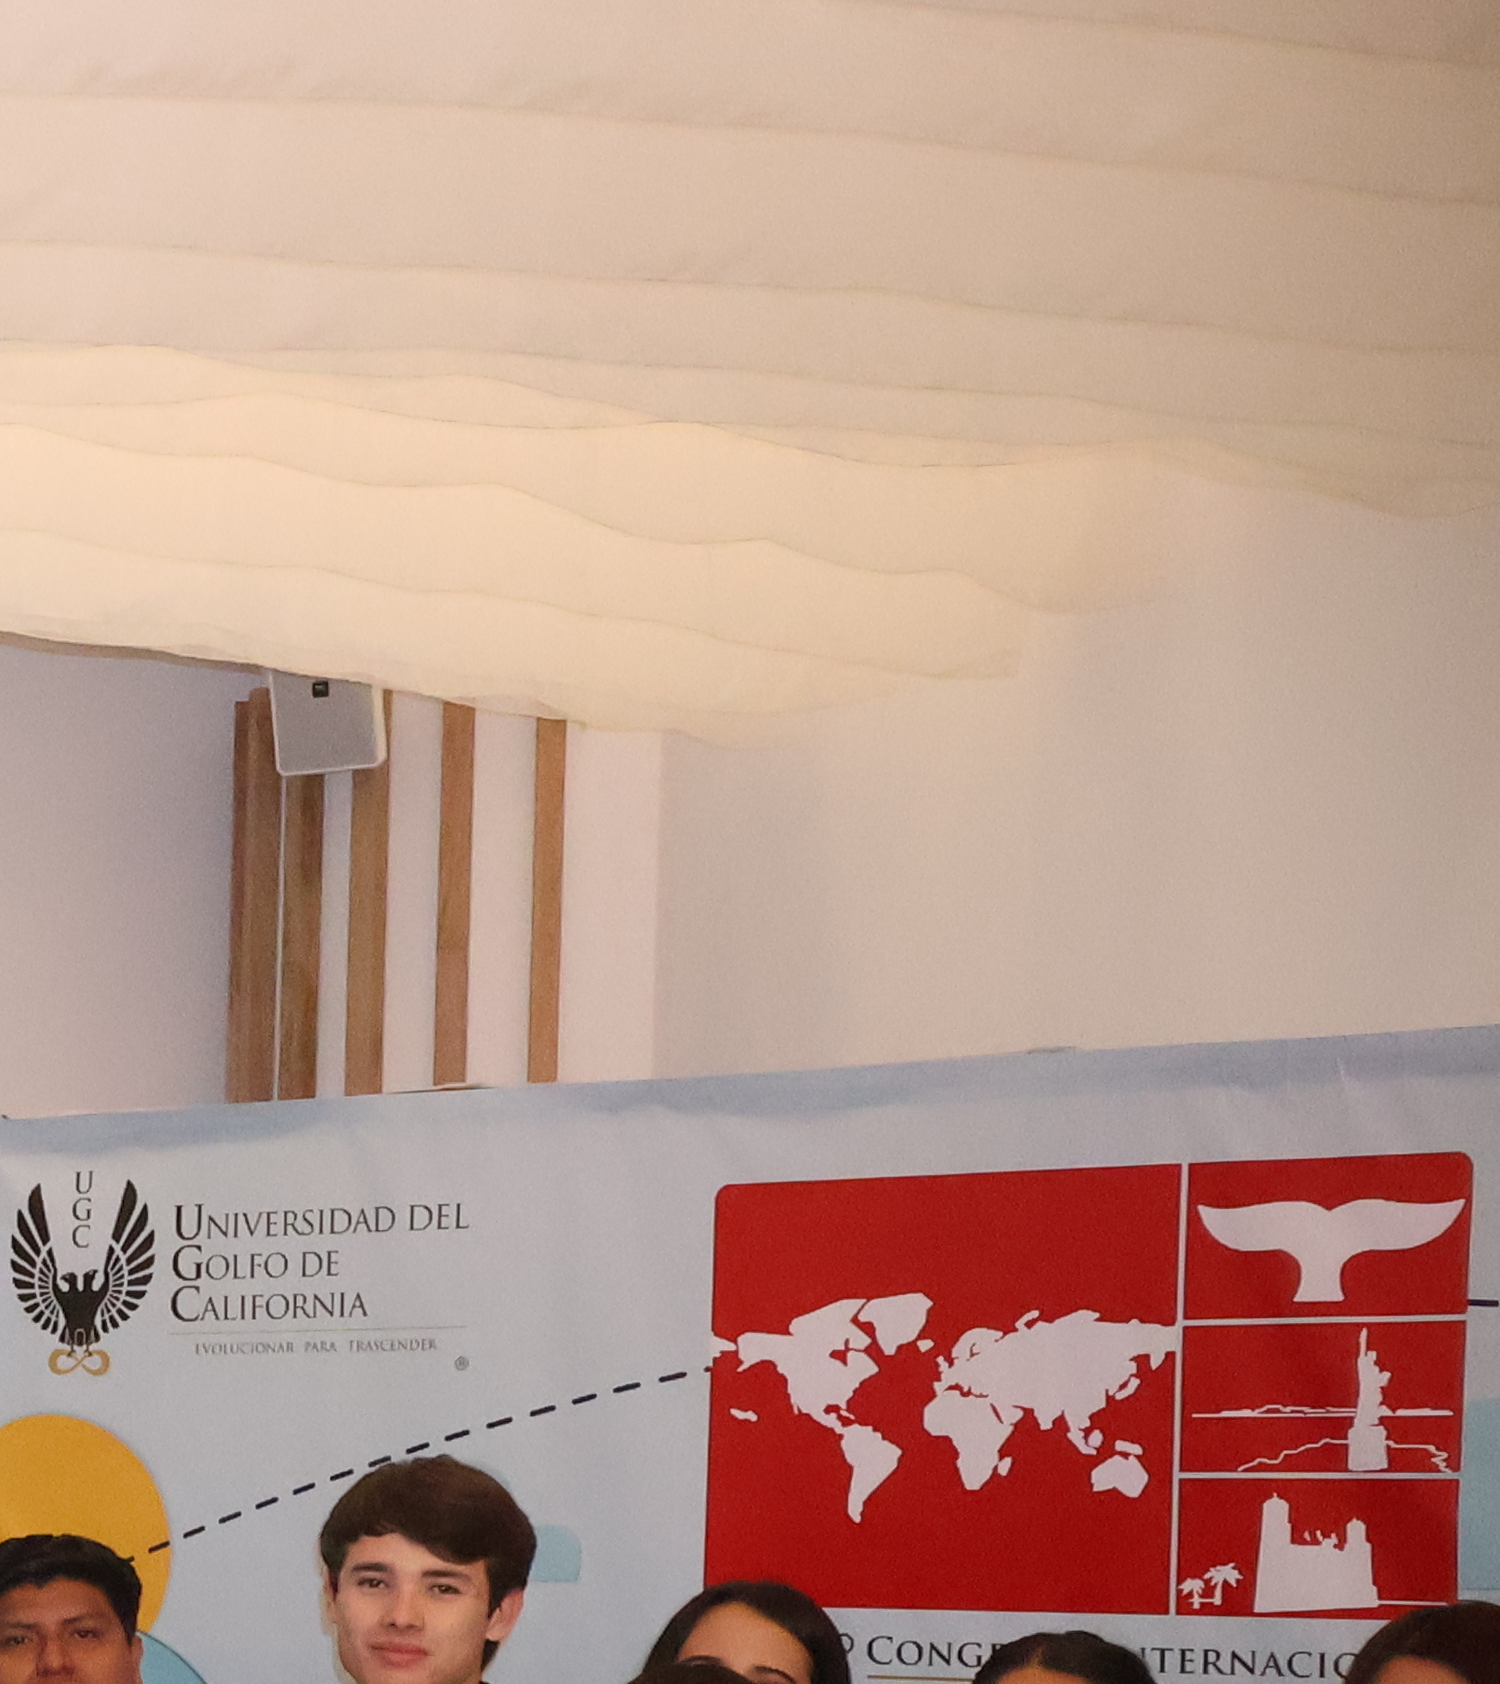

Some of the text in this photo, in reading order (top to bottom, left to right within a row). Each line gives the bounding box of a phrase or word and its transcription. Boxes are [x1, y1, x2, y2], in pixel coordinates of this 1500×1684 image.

[174, 1202, 470, 1241] UNIVERSIDAD DEL
[172, 1244, 340, 1282] GOLFO DE
[170, 1284, 368, 1323] CALIFORNIA
[304, 1340, 338, 1353] PARA
[349, 1337, 438, 1353] TRASCENDER
[1141, 1647, 1358, 1679] TERNACIO
